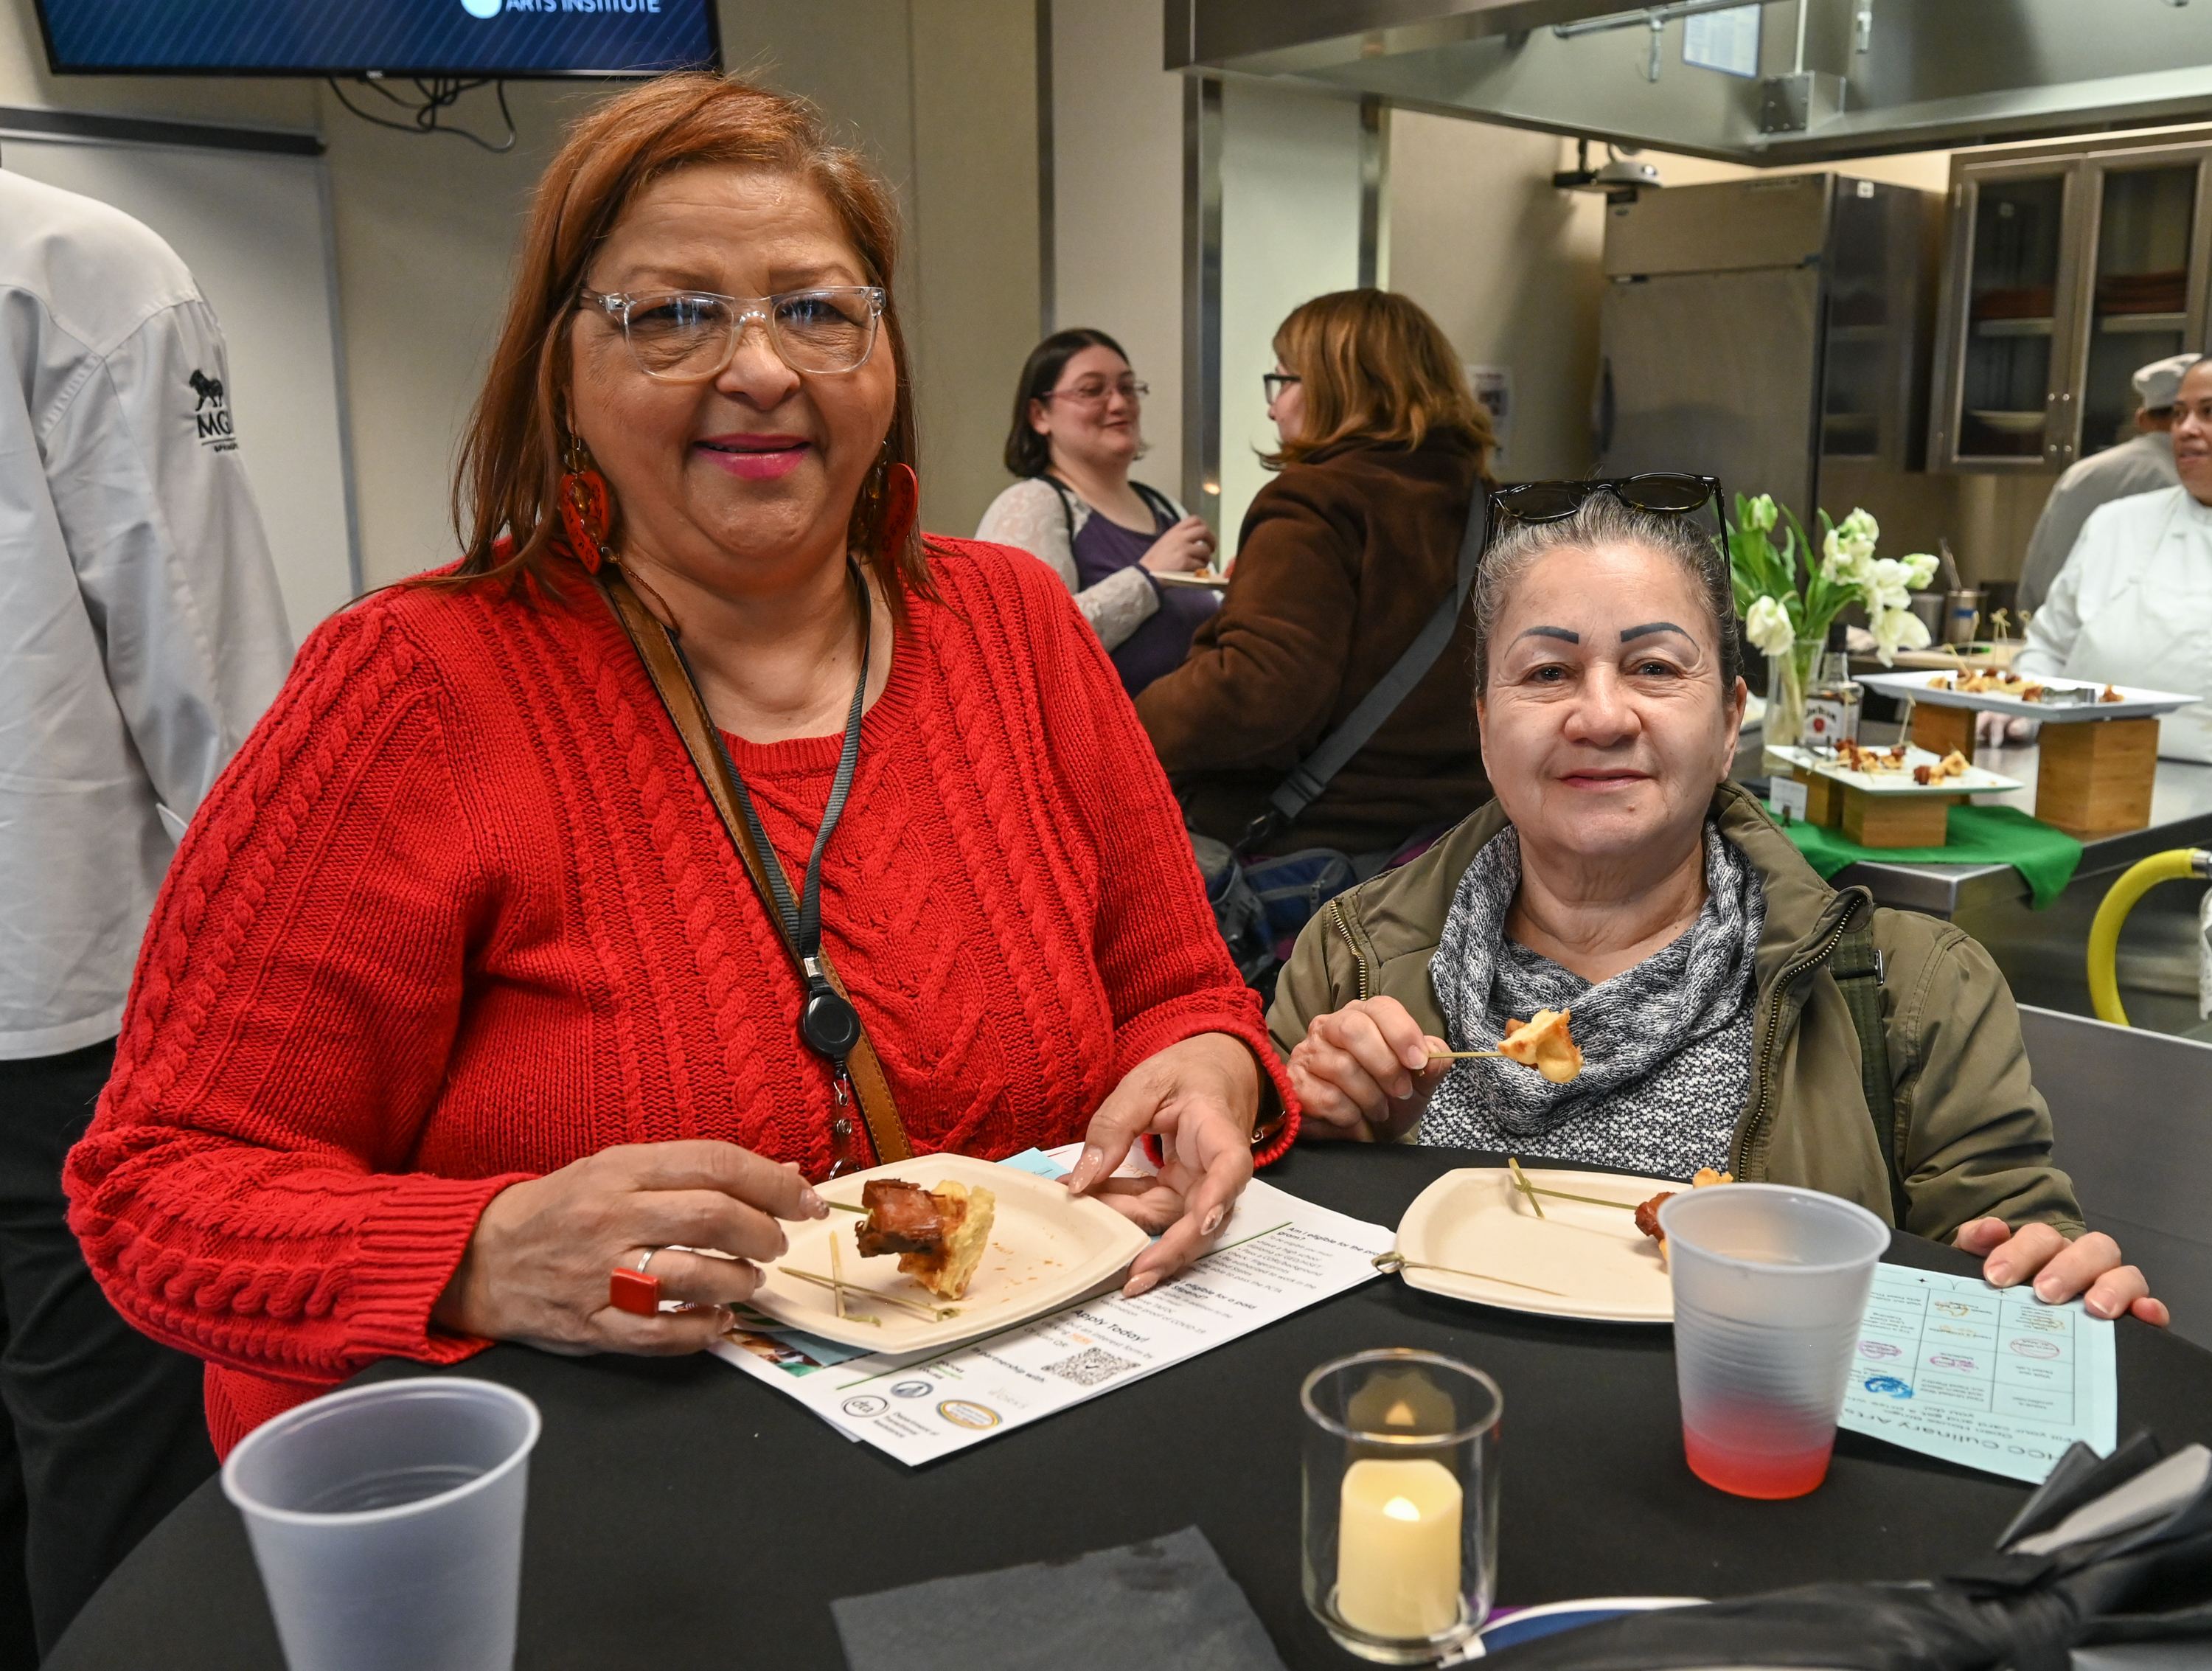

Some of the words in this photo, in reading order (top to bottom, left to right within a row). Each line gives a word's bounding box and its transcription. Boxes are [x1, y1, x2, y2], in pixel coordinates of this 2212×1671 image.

[1307, 1234, 1336, 1243] eligible
[1185, 1283, 1214, 1295] eligible
[1071, 1310, 1103, 1325] Apply
[1107, 1324, 1150, 1341] Today!
[1845, 1408, 1891, 1424] Arts
[1899, 1422, 1999, 1449] Culinary
